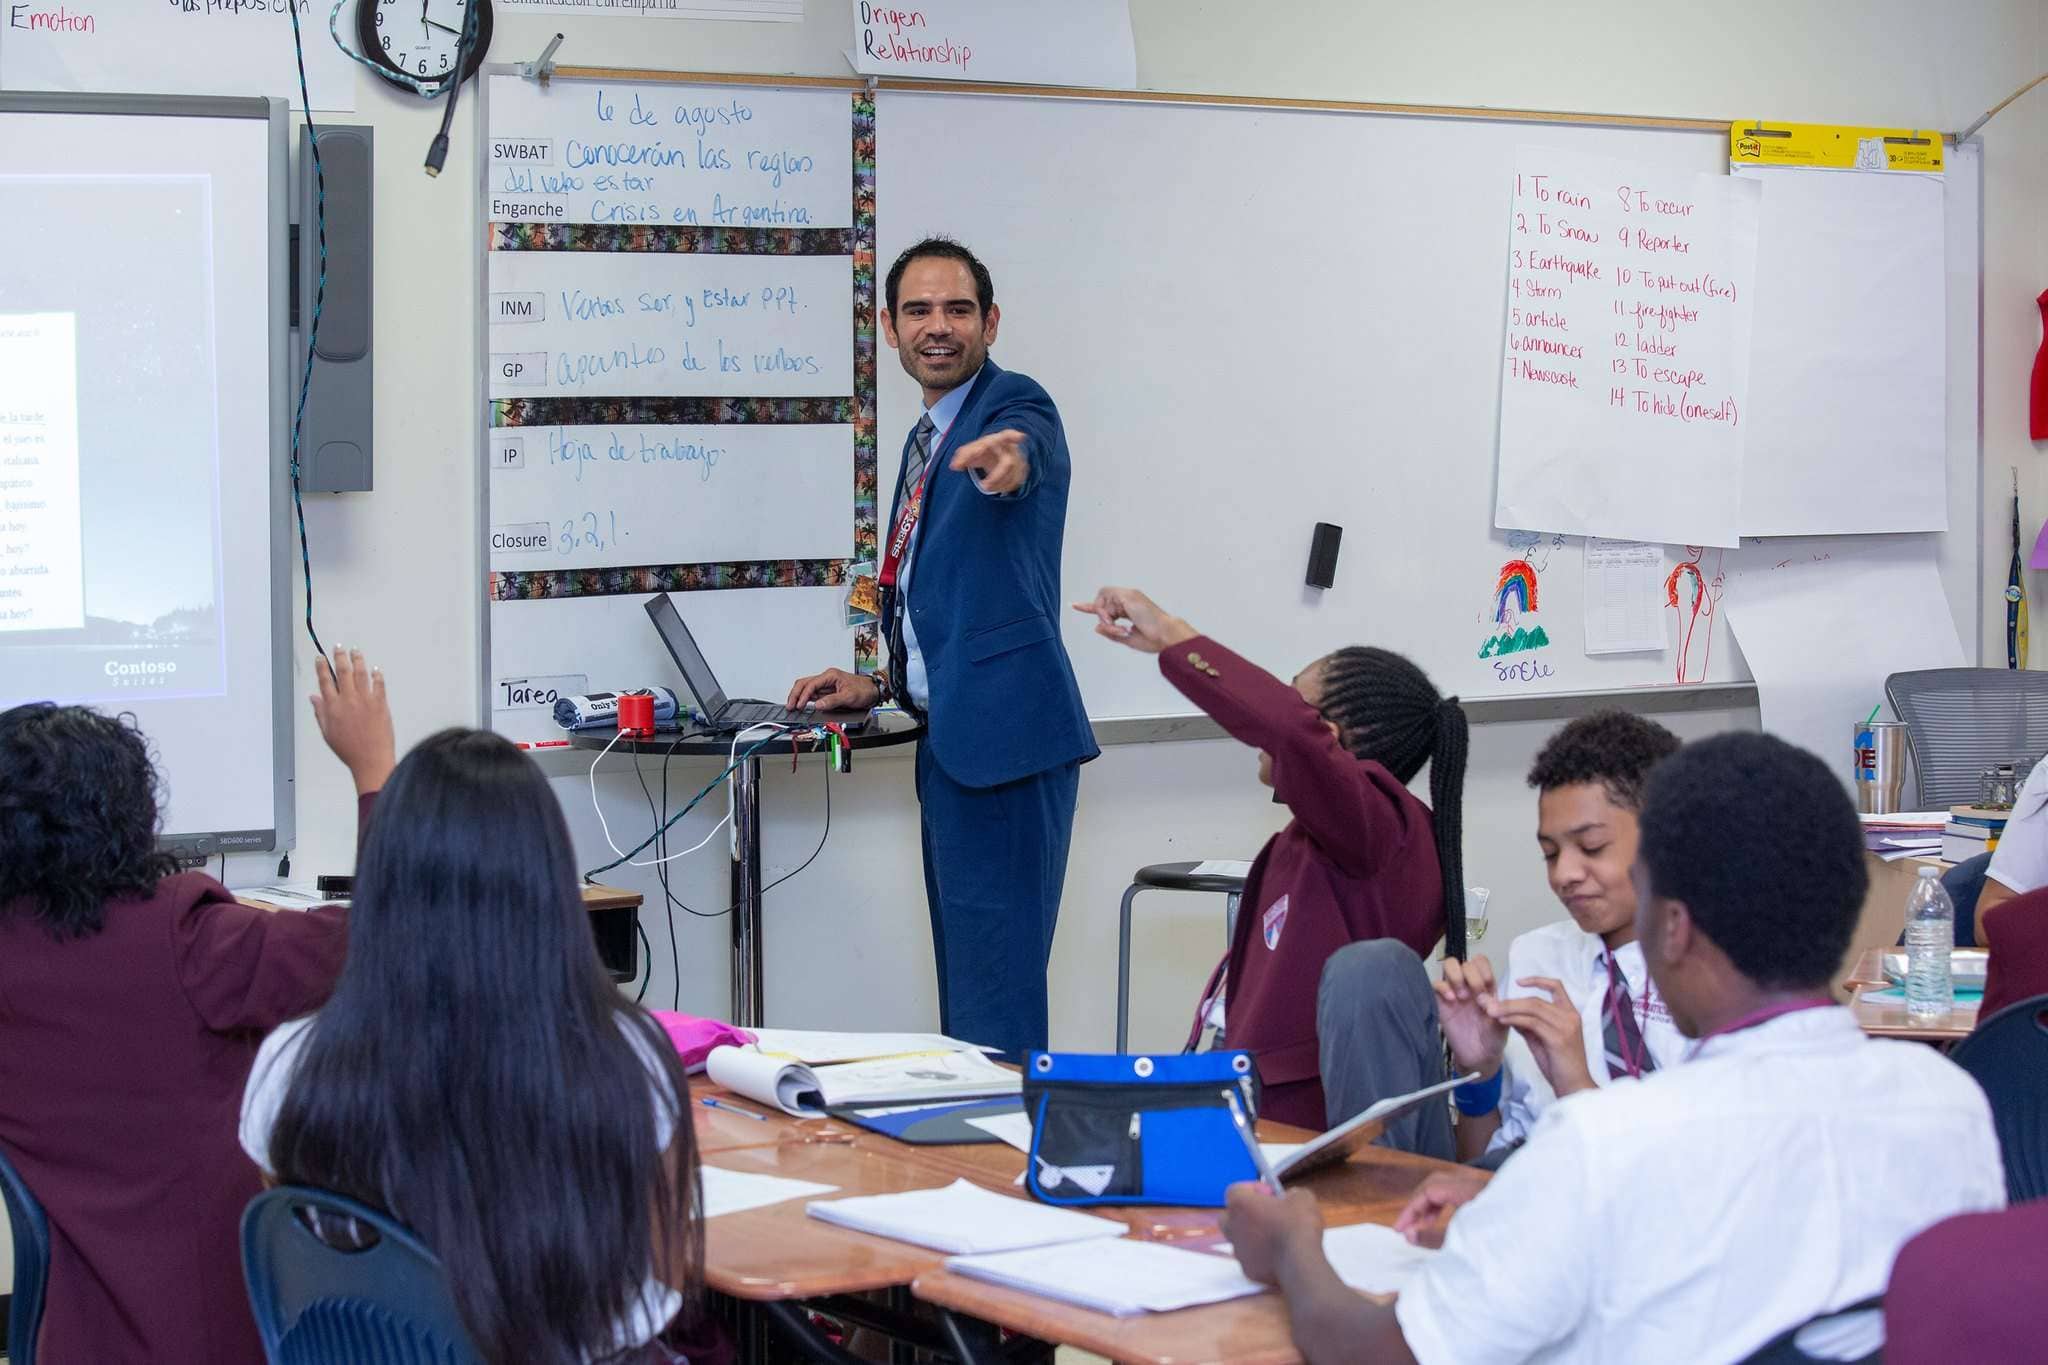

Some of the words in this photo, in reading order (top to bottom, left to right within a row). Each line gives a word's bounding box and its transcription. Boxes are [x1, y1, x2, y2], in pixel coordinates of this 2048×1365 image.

[11, 5, 95, 33] Emotion
[206, 0, 310, 15] preposicin
[375, 12, 384, 27] 9
[861, 0, 926, 35] Origen
[382, 36, 391, 50] 8
[865, 29, 971, 72] Relationship
[398, 53, 407, 68] 7
[418, 59, 427, 74] 6
[440, 54, 448, 69] 5
[630, 93, 658, 126] de
[674, 100, 752, 136] agosto
[494, 143, 548, 160] SWBAT
[698, 139, 731, 170] las
[747, 150, 813, 188] reglas
[504, 166, 533, 193] del
[1530, 175, 1549, 202] To
[1557, 189, 1591, 210] rain
[493, 200, 563, 218] Enganche
[591, 199, 662, 223] Crisis
[673, 206, 698, 226] en
[1616, 185, 1631, 213] 8
[1634, 190, 1650, 213] To
[1655, 199, 1695, 216] occur
[1536, 213, 1551, 235] To
[1638, 227, 1690, 255] Reporter
[1529, 249, 1601, 285] Earthquake
[1616, 266, 1631, 287] 10
[1638, 270, 1655, 289] To
[1658, 274, 1677, 294] put
[1679, 277, 1700, 294] out
[1702, 272, 1737, 303] (fire)
[500, 301, 532, 316] INM
[685, 295, 695, 328] y
[1525, 310, 1569, 332] article
[1615, 299, 1624, 316] 11
[1629, 300, 1699, 332] firefighter
[682, 341, 706, 371] de
[718, 338, 742, 372] los
[1522, 335, 1584, 360] announcer
[1615, 331, 1629, 347] 12
[1637, 332, 1677, 357] ladder
[503, 363, 523, 378] GP
[1507, 356, 1517, 378] 7
[1612, 358, 1627, 374] 13
[1631, 358, 1648, 379] To
[1653, 367, 1706, 389] escape
[1610, 386, 1625, 407] 14
[1631, 390, 1649, 413] To
[1653, 391, 1678, 417] hide
[1681, 391, 1738, 426] (oneself)
[503, 449, 517, 464] IP
[550, 426, 597, 482] Hoja
[608, 431, 635, 462] de
[492, 533, 547, 549] Closure
[104, 660, 176, 676] Contoso
[501, 679, 558, 706] Tarea
[591, 702, 610, 711] Only
